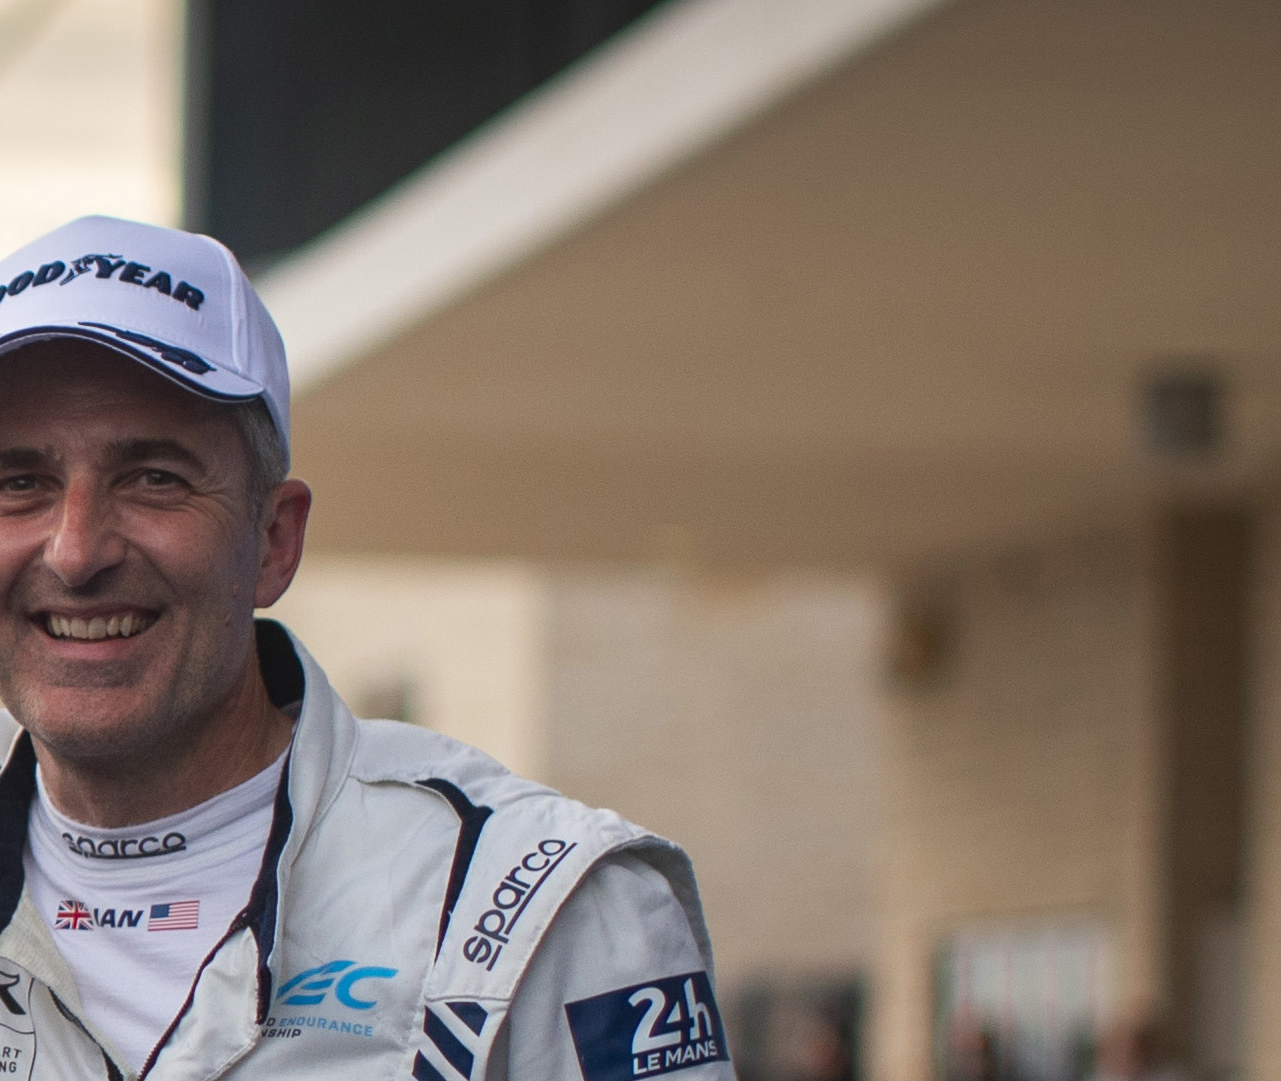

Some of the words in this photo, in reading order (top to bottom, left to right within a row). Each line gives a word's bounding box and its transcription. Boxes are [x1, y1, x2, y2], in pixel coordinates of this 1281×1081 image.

[62, 832, 186, 859] sparco
[94, 908, 144, 928] IAN
[463, 839, 571, 967] sparco
[276, 960, 398, 1010] EC
[278, 1017, 373, 1037] ENDURANCE
[628, 977, 713, 1054] 24h
[633, 1053, 660, 1074] LE
[666, 1040, 717, 1067] MANS
